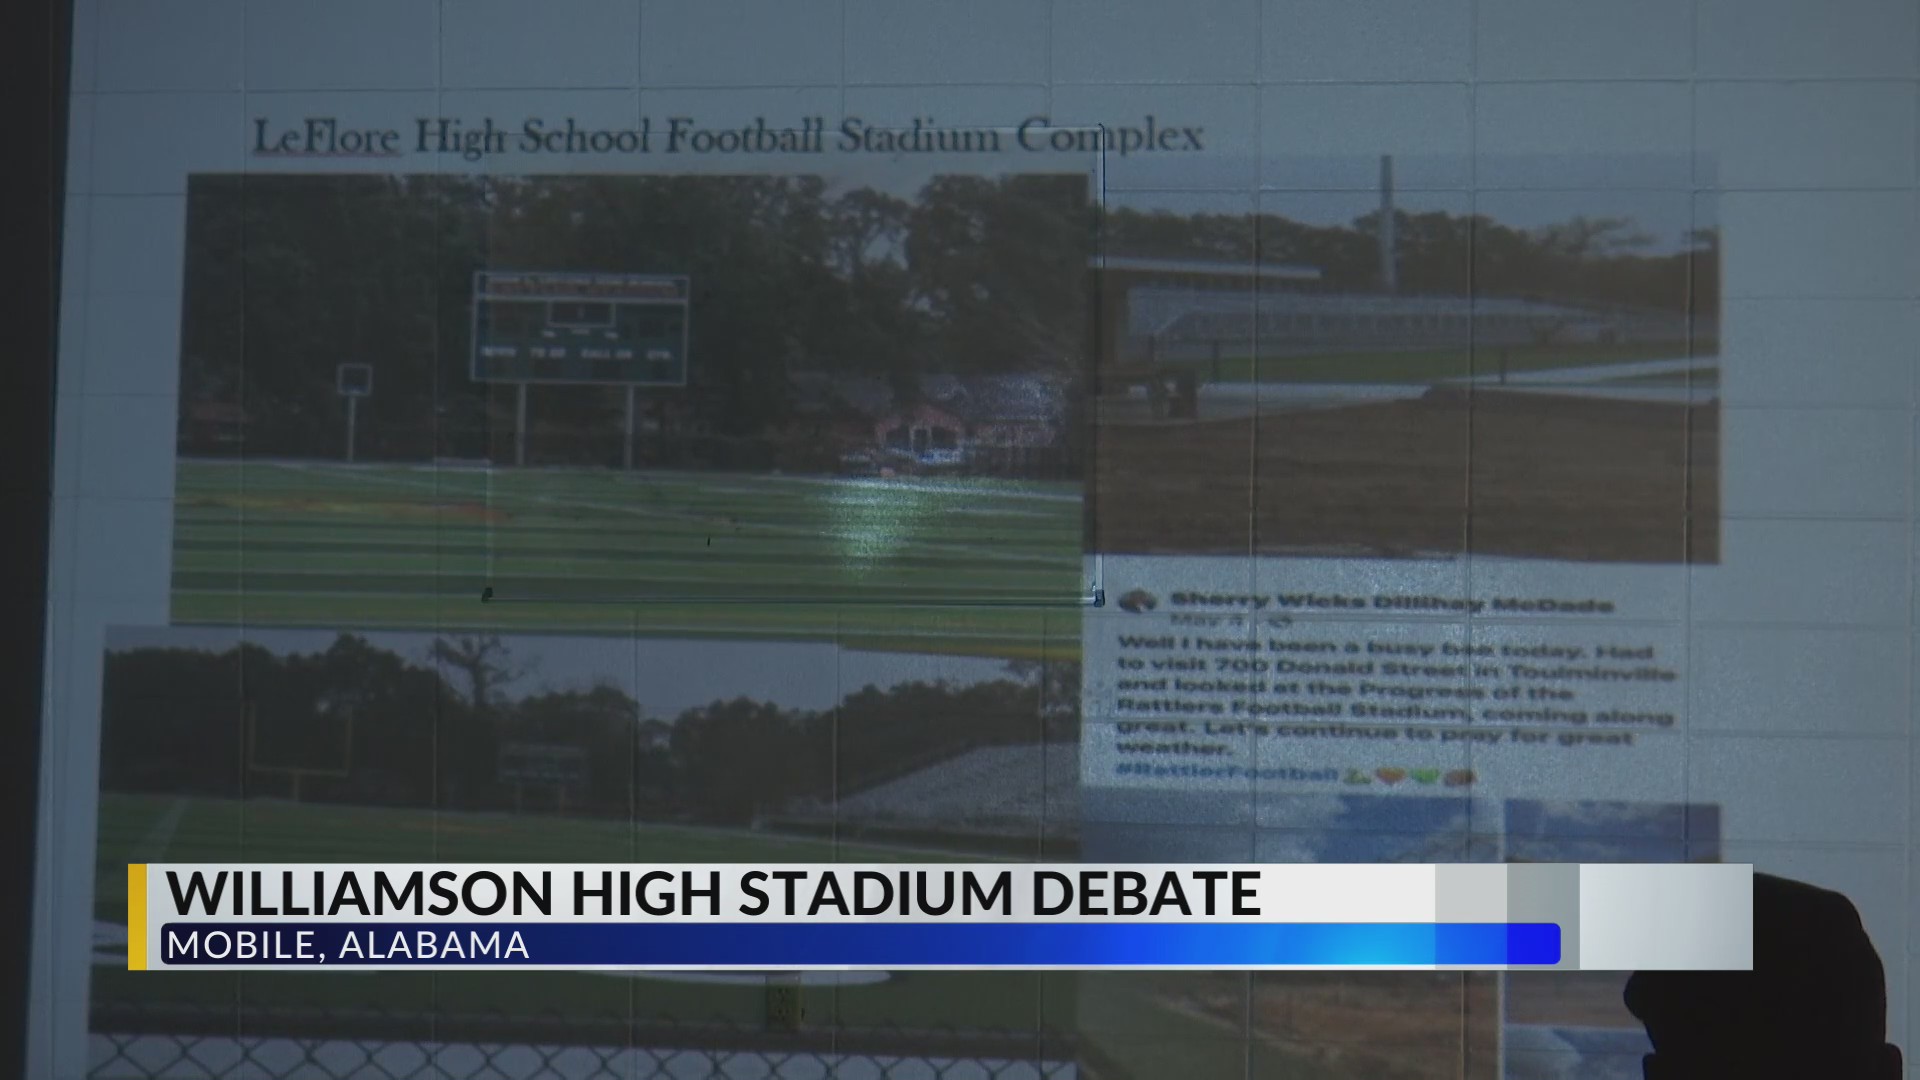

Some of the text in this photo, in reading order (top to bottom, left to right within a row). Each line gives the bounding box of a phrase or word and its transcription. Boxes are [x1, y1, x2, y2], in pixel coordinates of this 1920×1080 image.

[252, 115, 1206, 161] LeFlore High School Football Stadium Complex
[1171, 591, 1271, 611] Sherry
[1278, 593, 1366, 609] Wicks
[1493, 597, 1615, 613] McDade
[1118, 635, 1175, 650] Well
[1196, 636, 1262, 651] have
[1269, 637, 1337, 652] been
[1344, 641, 1361, 653] a
[1367, 639, 1435, 658] busy
[1441, 641, 1496, 656] bee
[1501, 643, 1588, 661] today.
[1596, 644, 1653, 659] Had
[1117, 655, 1679, 681] to visit 700 Donald Street in Toulminville
[1117, 677, 1575, 701] and looked at the Progress of the
[1117, 698, 1225, 714] Rattlers
[1232, 699, 1342, 716] Football
[1482, 706, 1588, 726] coming
[1596, 709, 1675, 728] along
[1276, 723, 1399, 739] continue
[1404, 726, 1434, 740] to
[1440, 729, 1502, 746] pray
[1510, 726, 1549, 743] for
[1557, 732, 1634, 747] great
[1115, 762, 1340, 781] #RattlerFootball
